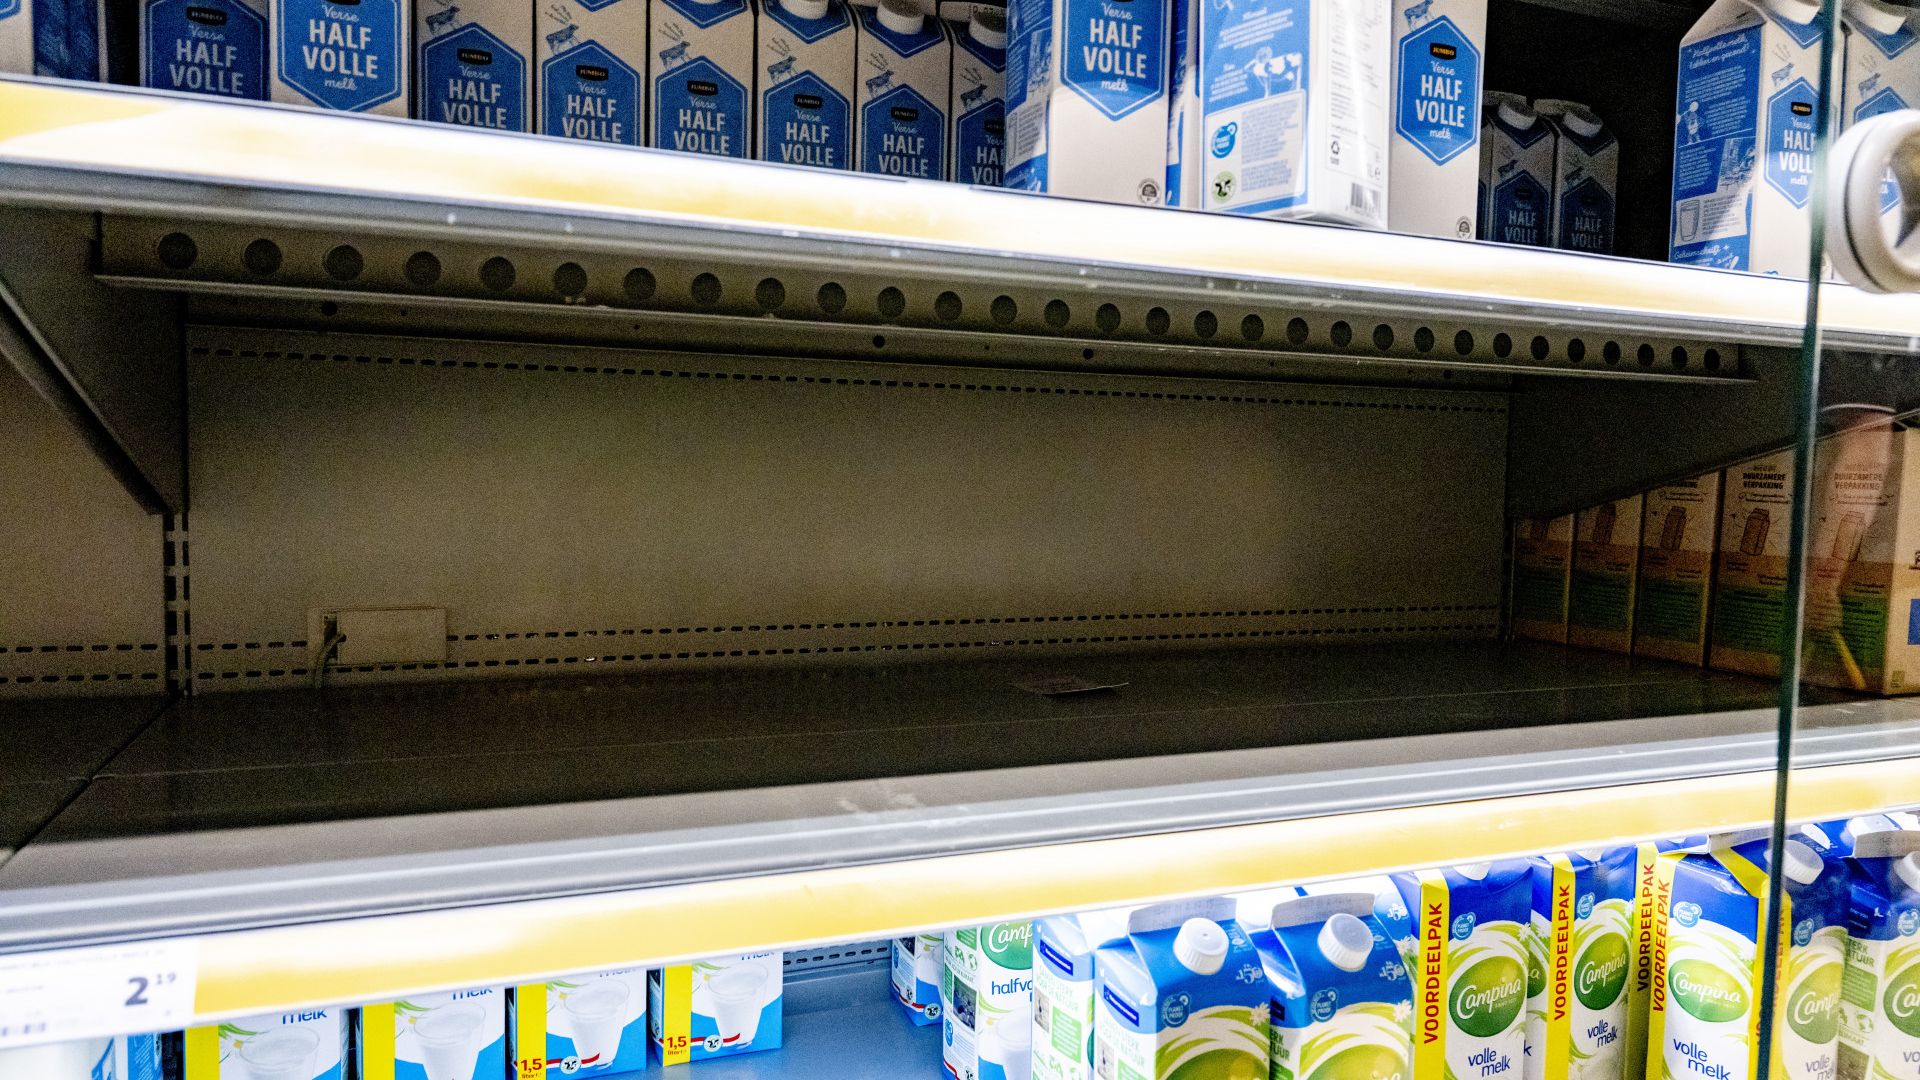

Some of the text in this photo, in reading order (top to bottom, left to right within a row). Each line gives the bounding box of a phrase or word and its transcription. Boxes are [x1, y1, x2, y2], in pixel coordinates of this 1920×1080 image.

[322, 4, 359, 22] Verse
[1101, 2, 1132, 20] Verse
[310, 18, 371, 50] HALF
[1090, 18, 1142, 48] HALF
[176, 38, 238, 68] HALF
[302, 45, 378, 79] VOLLE
[1432, 46, 1454, 56] JUMBO
[459, 66, 491, 80] Verse
[1083, 46, 1146, 79] VOLLE
[1430, 60, 1456, 76] Verse
[170, 64, 244, 95] VOLLE
[324, 77, 358, 91] melk
[577, 81, 607, 95] Verse
[1100, 75, 1129, 92] melk
[1420, 74, 1462, 102] HALF
[448, 79, 500, 104] HALF
[567, 94, 616, 118] HALF
[688, 96, 718, 110] Verse
[1416, 99, 1465, 128] VOLLE
[443, 102, 507, 128] VOLLE
[679, 108, 726, 132] HALF
[795, 110, 822, 122] Verse
[562, 116, 622, 142] VOLLE
[786, 122, 830, 144] HALF
[1429, 128, 1451, 140] melk
[674, 130, 730, 155] VOLLE
[884, 133, 924, 155] HALF
[780, 142, 834, 166] VOLLE
[1779, 152, 1813, 174] VOLL
[878, 154, 928, 177] VOLLE
[972, 166, 1003, 186] VOL
[1508, 210, 1537, 227] HALF
[1504, 226, 1538, 244] VOLLE
[1743, 482, 1784, 490] VERPAKKING
[1834, 482, 1880, 490] VERPAKKING
[988, 922, 1032, 953] Camp
[1637, 863, 1654, 992] VOORDEELPAK
[1554, 884, 1570, 1020] VOORDEELPAK
[1653, 880, 1670, 1012] VOORDEELPAK
[1424, 903, 1442, 1044] VOORDEELPAK
[1580, 953, 1626, 994] Campina
[992, 978, 1032, 996] halfvo
[1672, 972, 1741, 1003] Campina
[1456, 978, 1520, 1020] Campina
[1794, 992, 1838, 1025] Camp
[1588, 1019, 1608, 1038] volle
[1597, 1026, 1618, 1048] melk
[666, 1036, 686, 1050] 1,5
[1672, 1038, 1708, 1062] volle
[520, 1058, 542, 1073] 1,5
[1468, 1047, 1496, 1066] volle
[1482, 1055, 1510, 1077] melk
[1806, 1054, 1830, 1072] volle
[1688, 1058, 1731, 1080] melk
